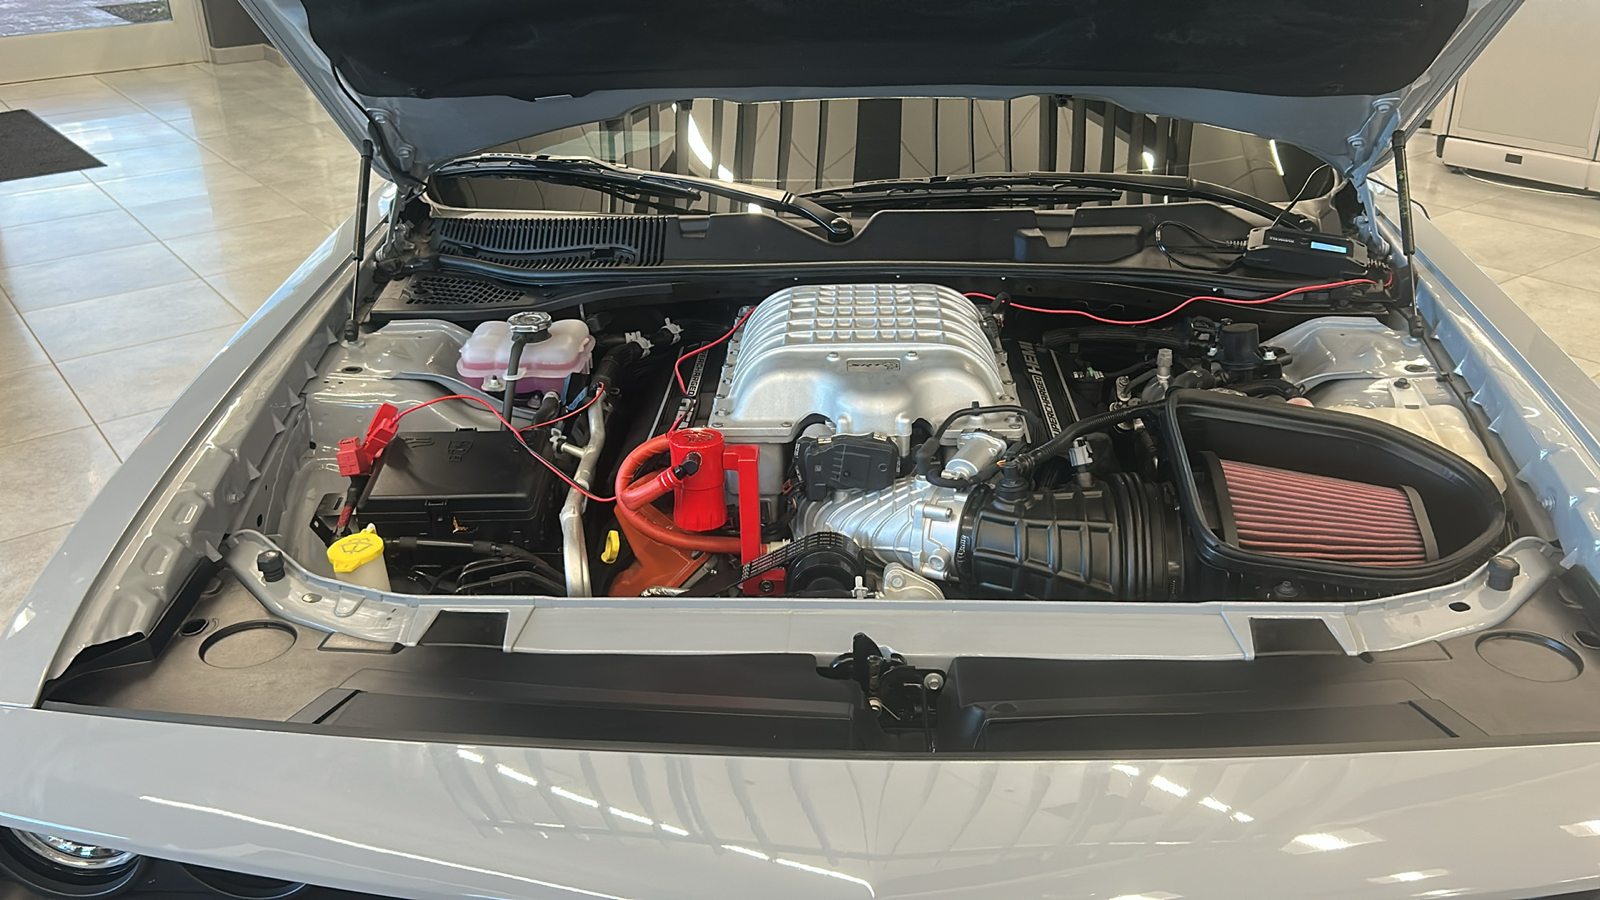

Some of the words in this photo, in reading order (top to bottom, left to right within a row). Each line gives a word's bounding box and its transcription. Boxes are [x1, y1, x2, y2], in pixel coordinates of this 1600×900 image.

[688, 342, 709, 396] PERCHARGED
[1019, 341, 1042, 375] HEMI
[1033, 375, 1062, 437] UPERCHARGED
